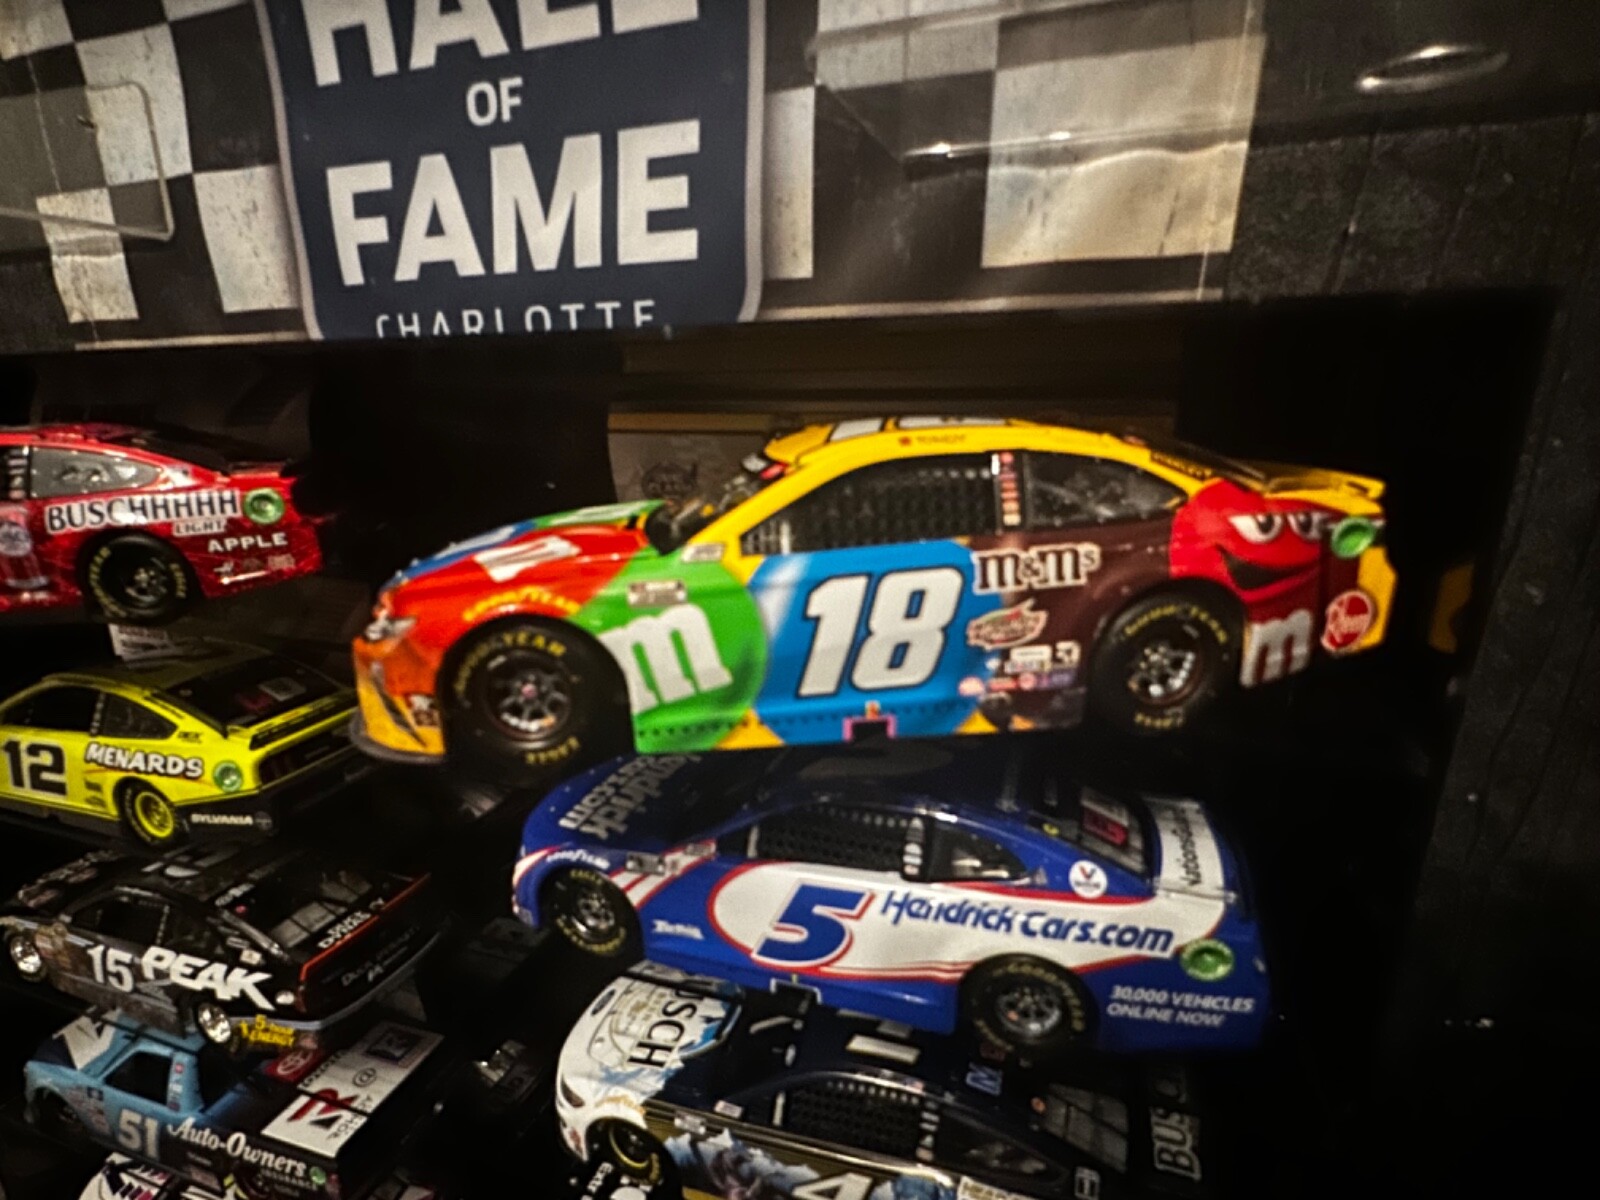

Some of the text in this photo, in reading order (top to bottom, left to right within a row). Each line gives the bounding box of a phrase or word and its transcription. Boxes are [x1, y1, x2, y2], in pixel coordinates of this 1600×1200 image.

[303, 0, 700, 87] HA
[465, 76, 524, 127] OF
[326, 118, 701, 287] FAME
[175, 520, 224, 535] LIGHT
[209, 532, 289, 552] APPLE
[797, 567, 966, 699] 18
[2, 738, 68, 797] 12
[85, 741, 205, 779] MENARDS
[190, 811, 255, 827] SYLVANIA
[754, 879, 875, 966] 5
[87, 944, 136, 993] 15
[140, 945, 276, 1012] PEAK
[1106, 1001, 1226, 1028] ONLINE NOW
[1171, 992, 1256, 1016] VEHICLES
[118, 1107, 160, 1161] 51
[166, 1115, 307, 1180] Auto-Owners
